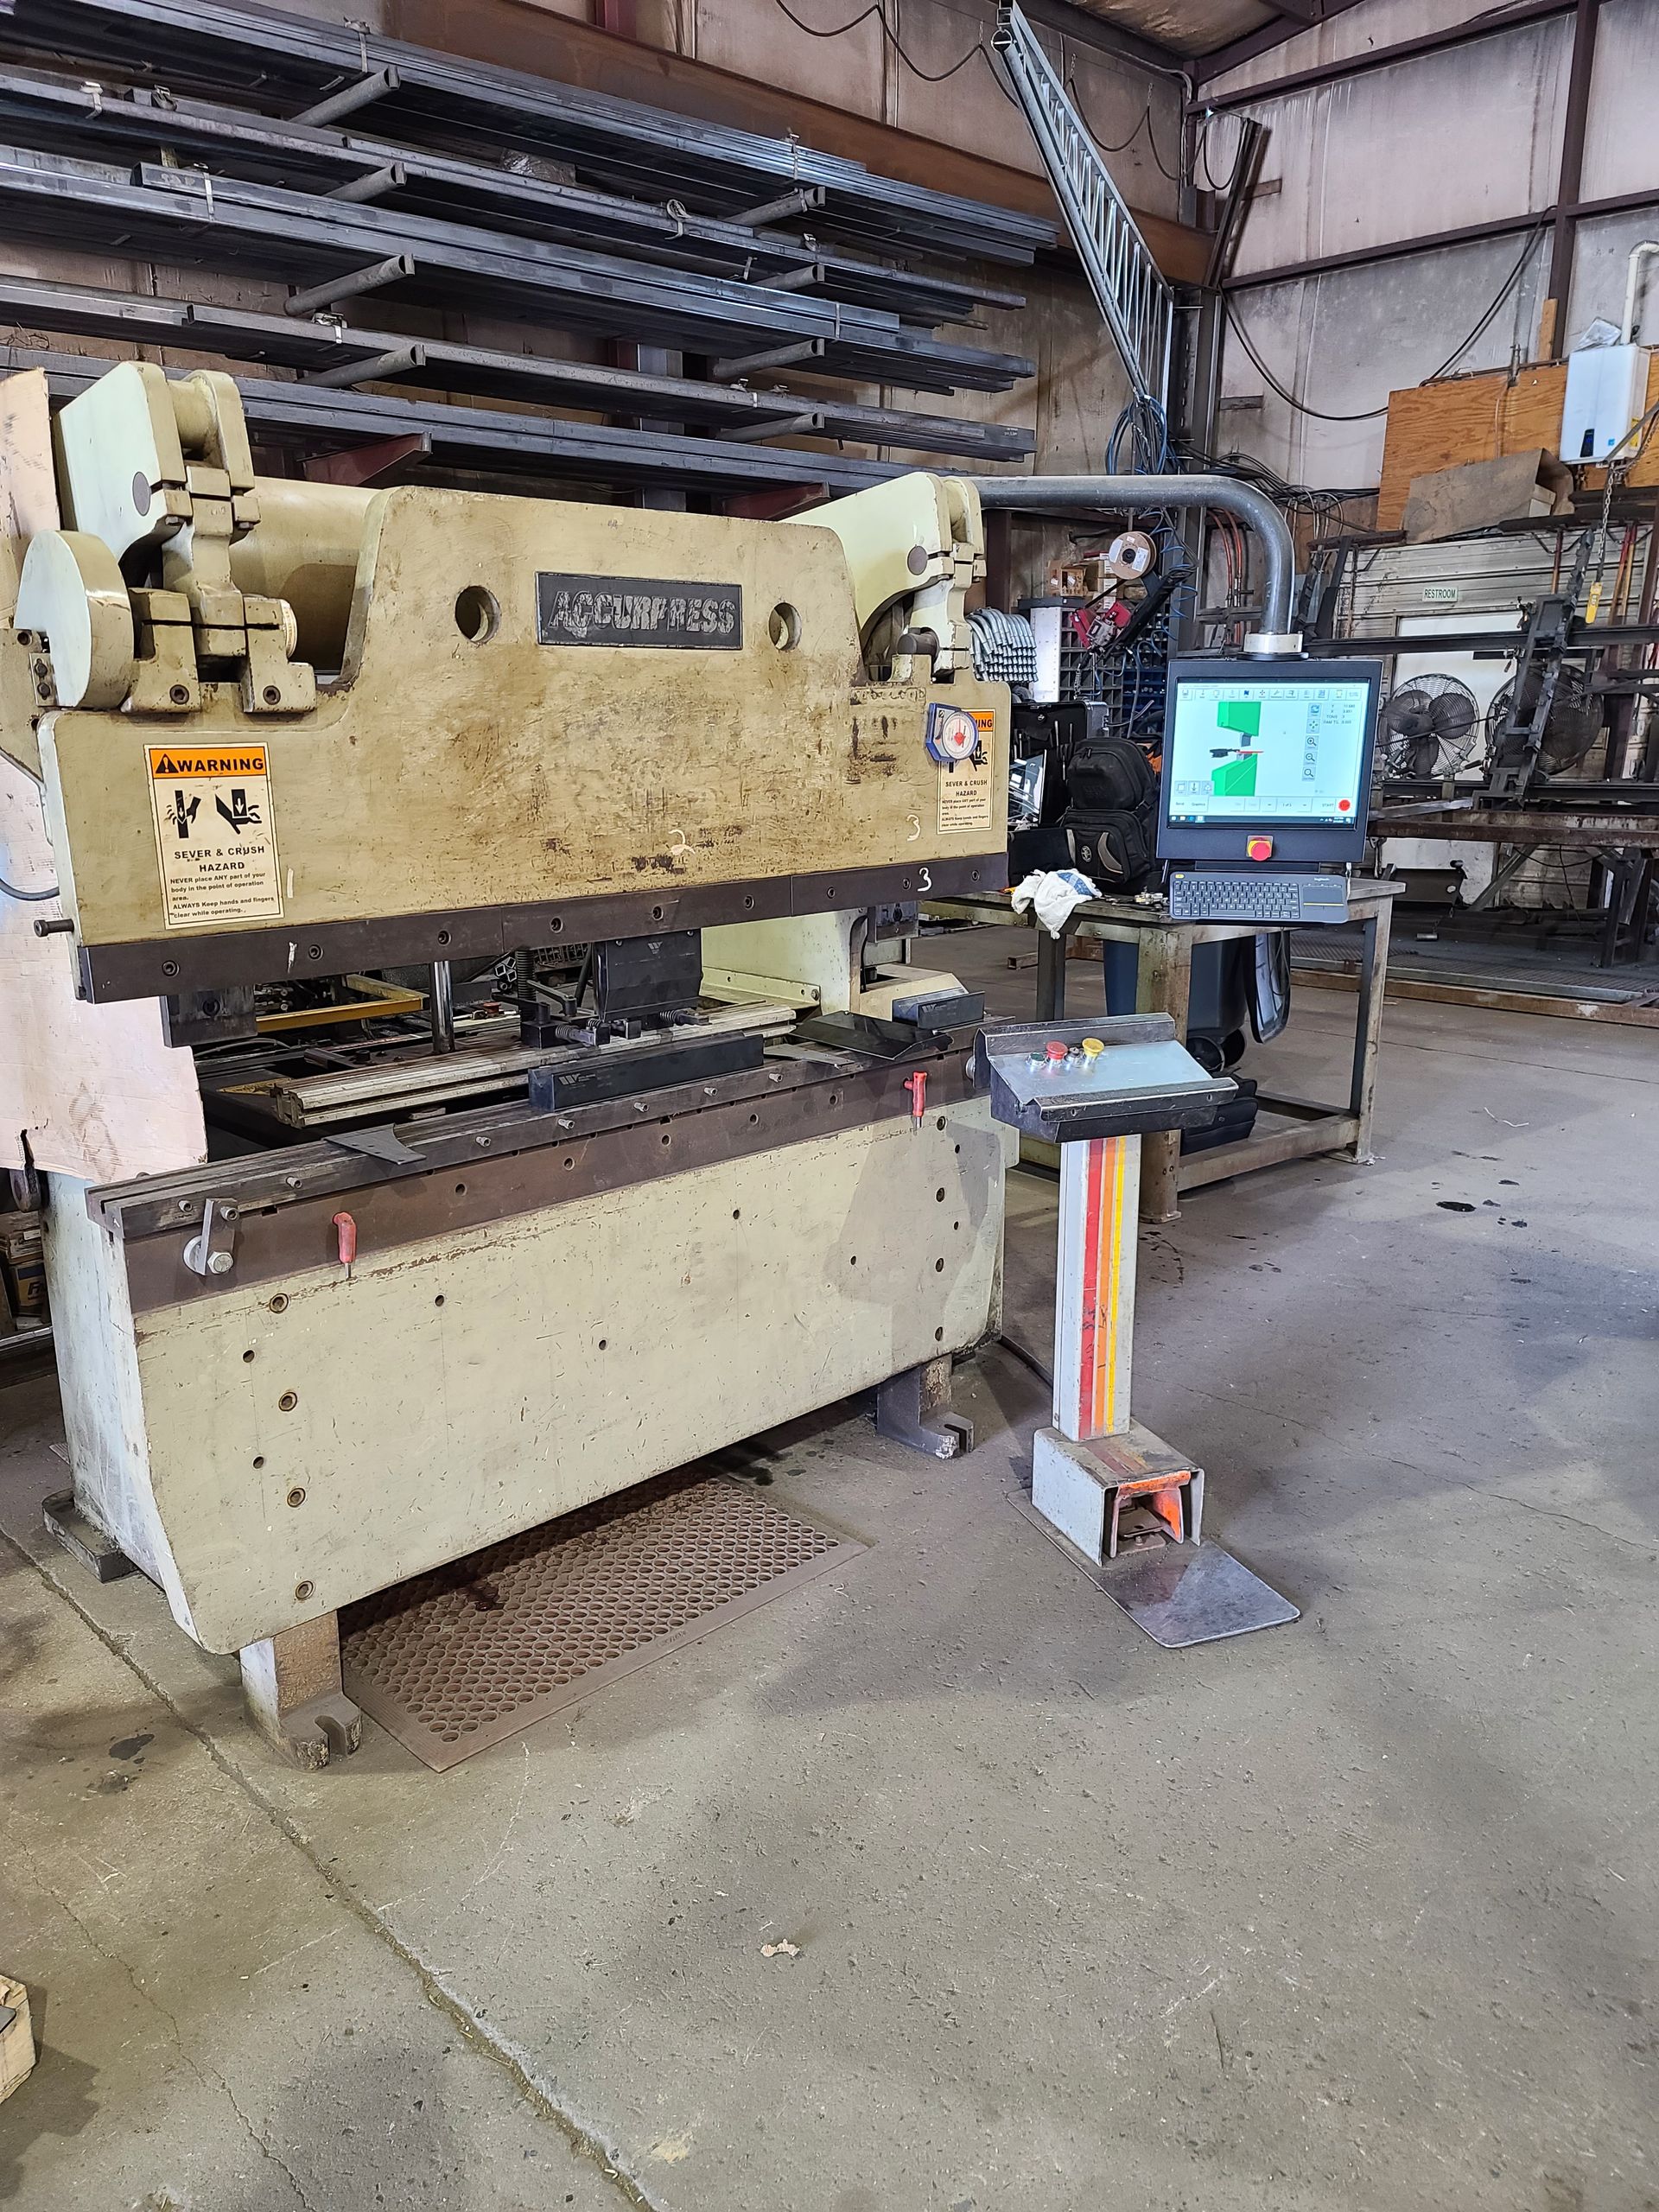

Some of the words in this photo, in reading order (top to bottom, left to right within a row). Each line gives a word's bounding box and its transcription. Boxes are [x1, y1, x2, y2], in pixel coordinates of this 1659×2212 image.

[1424, 588, 1456, 599] RESTROOM
[548, 590, 734, 636] ACCURPRESS
[176, 758, 264, 772] WARNING
[906, 815, 921, 842] 3
[174, 849, 212, 860] SEVER
[227, 846, 264, 856] CRUSH
[199, 861, 245, 872] HAZARD
[917, 867, 932, 892] 3
